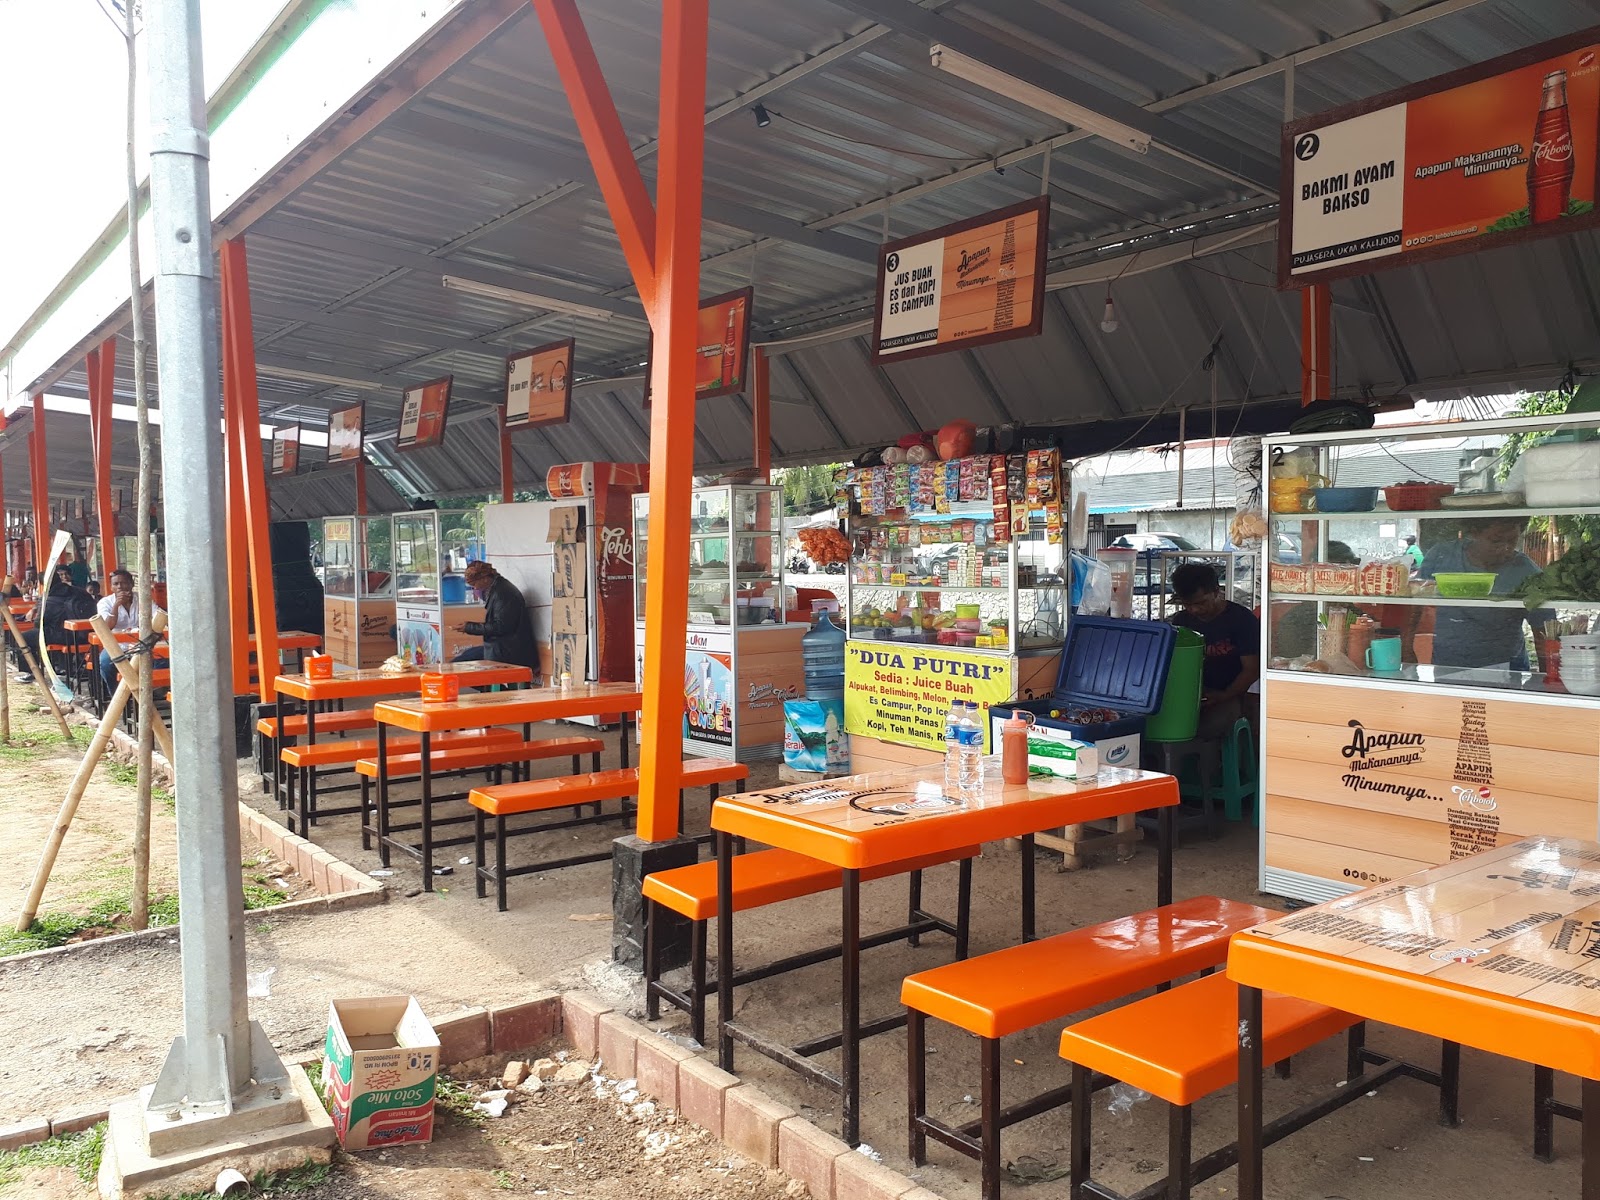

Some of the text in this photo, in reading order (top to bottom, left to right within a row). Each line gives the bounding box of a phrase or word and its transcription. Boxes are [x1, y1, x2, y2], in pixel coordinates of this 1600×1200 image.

[1301, 136, 1314, 159] 2
[1414, 143, 1523, 179] Apapun Makanannya,
[1464, 155, 1528, 177] Minumnya...
[1302, 160, 1395, 201] BAKMI AYAM
[1323, 188, 1370, 215] BAKSO
[1293, 234, 1400, 265] PUJASERA UKM KALIJODO
[895, 265, 932, 286] JUS BUAH
[889, 279, 936, 301] ES dan KOPI
[890, 294, 934, 315] ES CAMPUR
[1272, 446, 1285, 467] 2
[601, 526, 640, 567] Tehb
[690, 634, 708, 647] UKM
[849, 681, 878, 694] Alpukat,
[880, 686, 921, 701] Belimbing,
[923, 692, 949, 705] Melon,
[874, 670, 903, 684] Sedia
[912, 675, 942, 690] Juice
[945, 680, 974, 694] Buah
[869, 696, 878, 705] Es
[881, 698, 914, 712] Campur,
[917, 704, 932, 714] Pop
[689, 711, 731, 733] ONDEL
[876, 709, 911, 723] Minuman
[914, 716, 939, 728] Panas
[1462, 718, 1486, 728] Gudeg
[867, 719, 887, 732] Kopi,
[890, 724, 905, 734] Teh
[908, 727, 934, 741] Manis,
[1342, 719, 1425, 758] Apapun
[784, 740, 805, 750] nerale
[1349, 752, 1422, 772] Makanannya,
[1455, 762, 1493, 773] APAPUN
[1342, 774, 1443, 801] Minumnya...
[1451, 785, 1497, 812] Tehbotol
[1447, 808, 1472, 817] Dendeng
[1450, 830, 1497, 843] Kerak Telor
[1450, 842, 1469, 850] Nasi
[367, 1088, 423, 1105] Soto Mie
